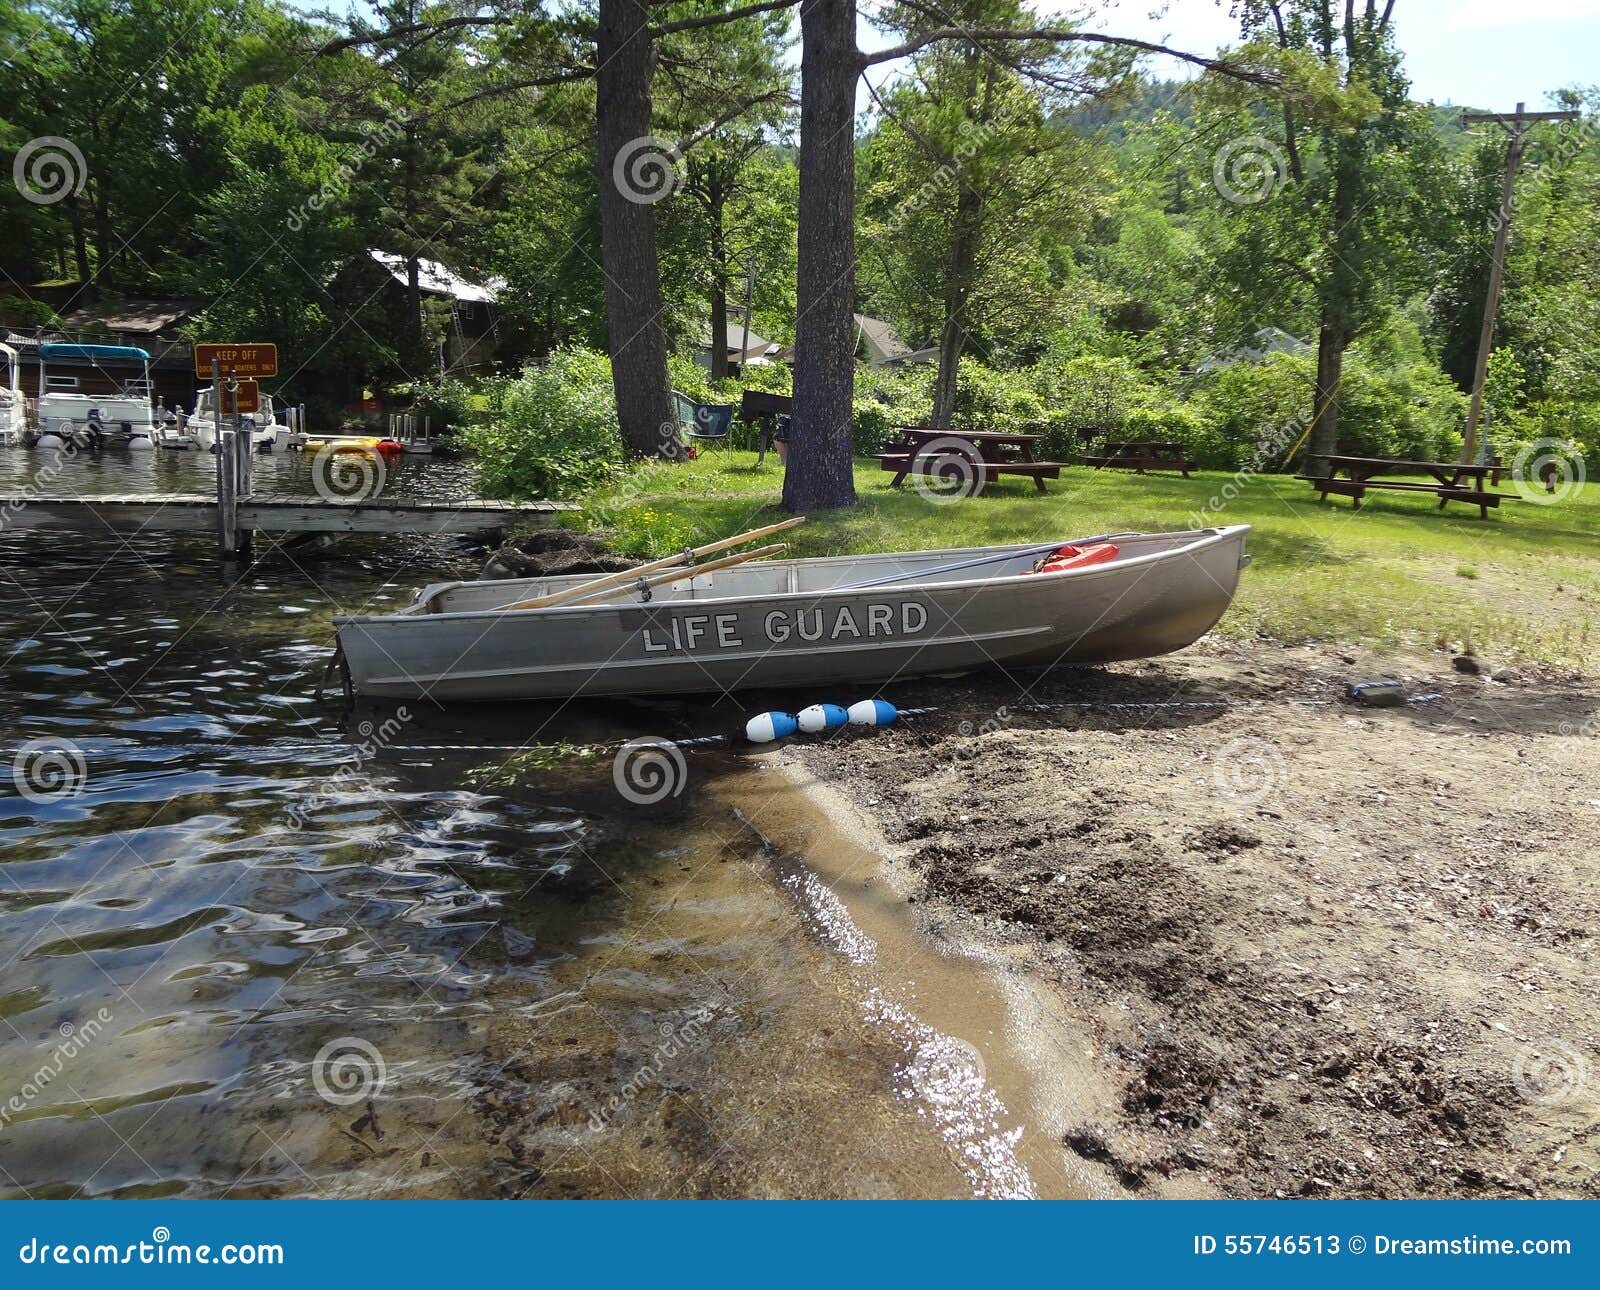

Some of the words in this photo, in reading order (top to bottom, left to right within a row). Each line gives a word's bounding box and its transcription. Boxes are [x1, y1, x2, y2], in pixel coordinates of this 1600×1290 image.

[216, 350, 238, 361] KEEP
[241, 350, 257, 360] OFF
[642, 614, 743, 652] LIFE
[763, 601, 929, 643] GUARD
